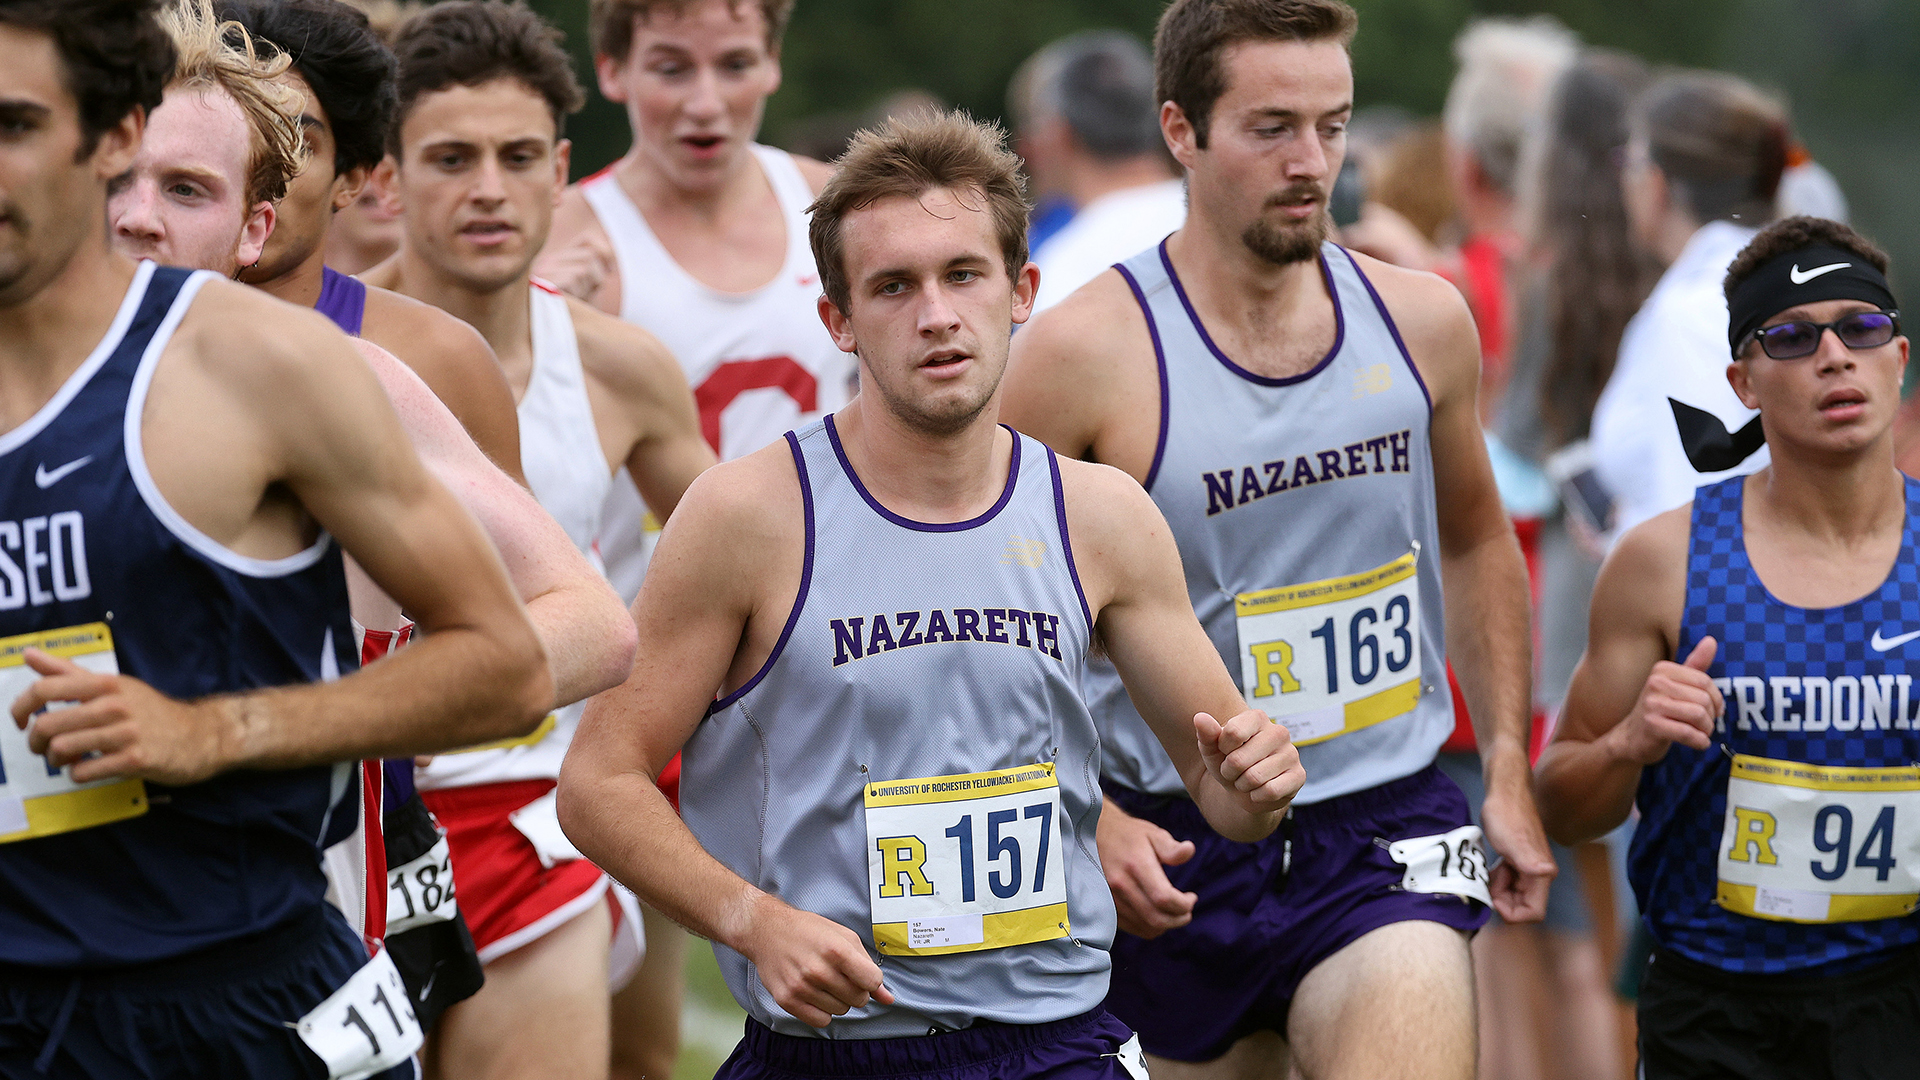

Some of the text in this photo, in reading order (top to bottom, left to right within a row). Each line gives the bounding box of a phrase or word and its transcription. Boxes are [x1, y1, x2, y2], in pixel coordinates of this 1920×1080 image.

[1202, 429, 1412, 517] NAZARETH
[829, 607, 1063, 668] NAZARETH
[1311, 594, 1412, 694] 163
[1248, 639, 1301, 699] R
[1713, 674, 1920, 734] REDONI
[878, 770, 1047, 797] UNIVERSITY OF ROCHESTER YELLOWJACKET INVITATIONAL
[876, 834, 935, 898] R
[945, 802, 1053, 903] 157
[1728, 806, 1778, 865] R
[1810, 804, 1897, 882] 94
